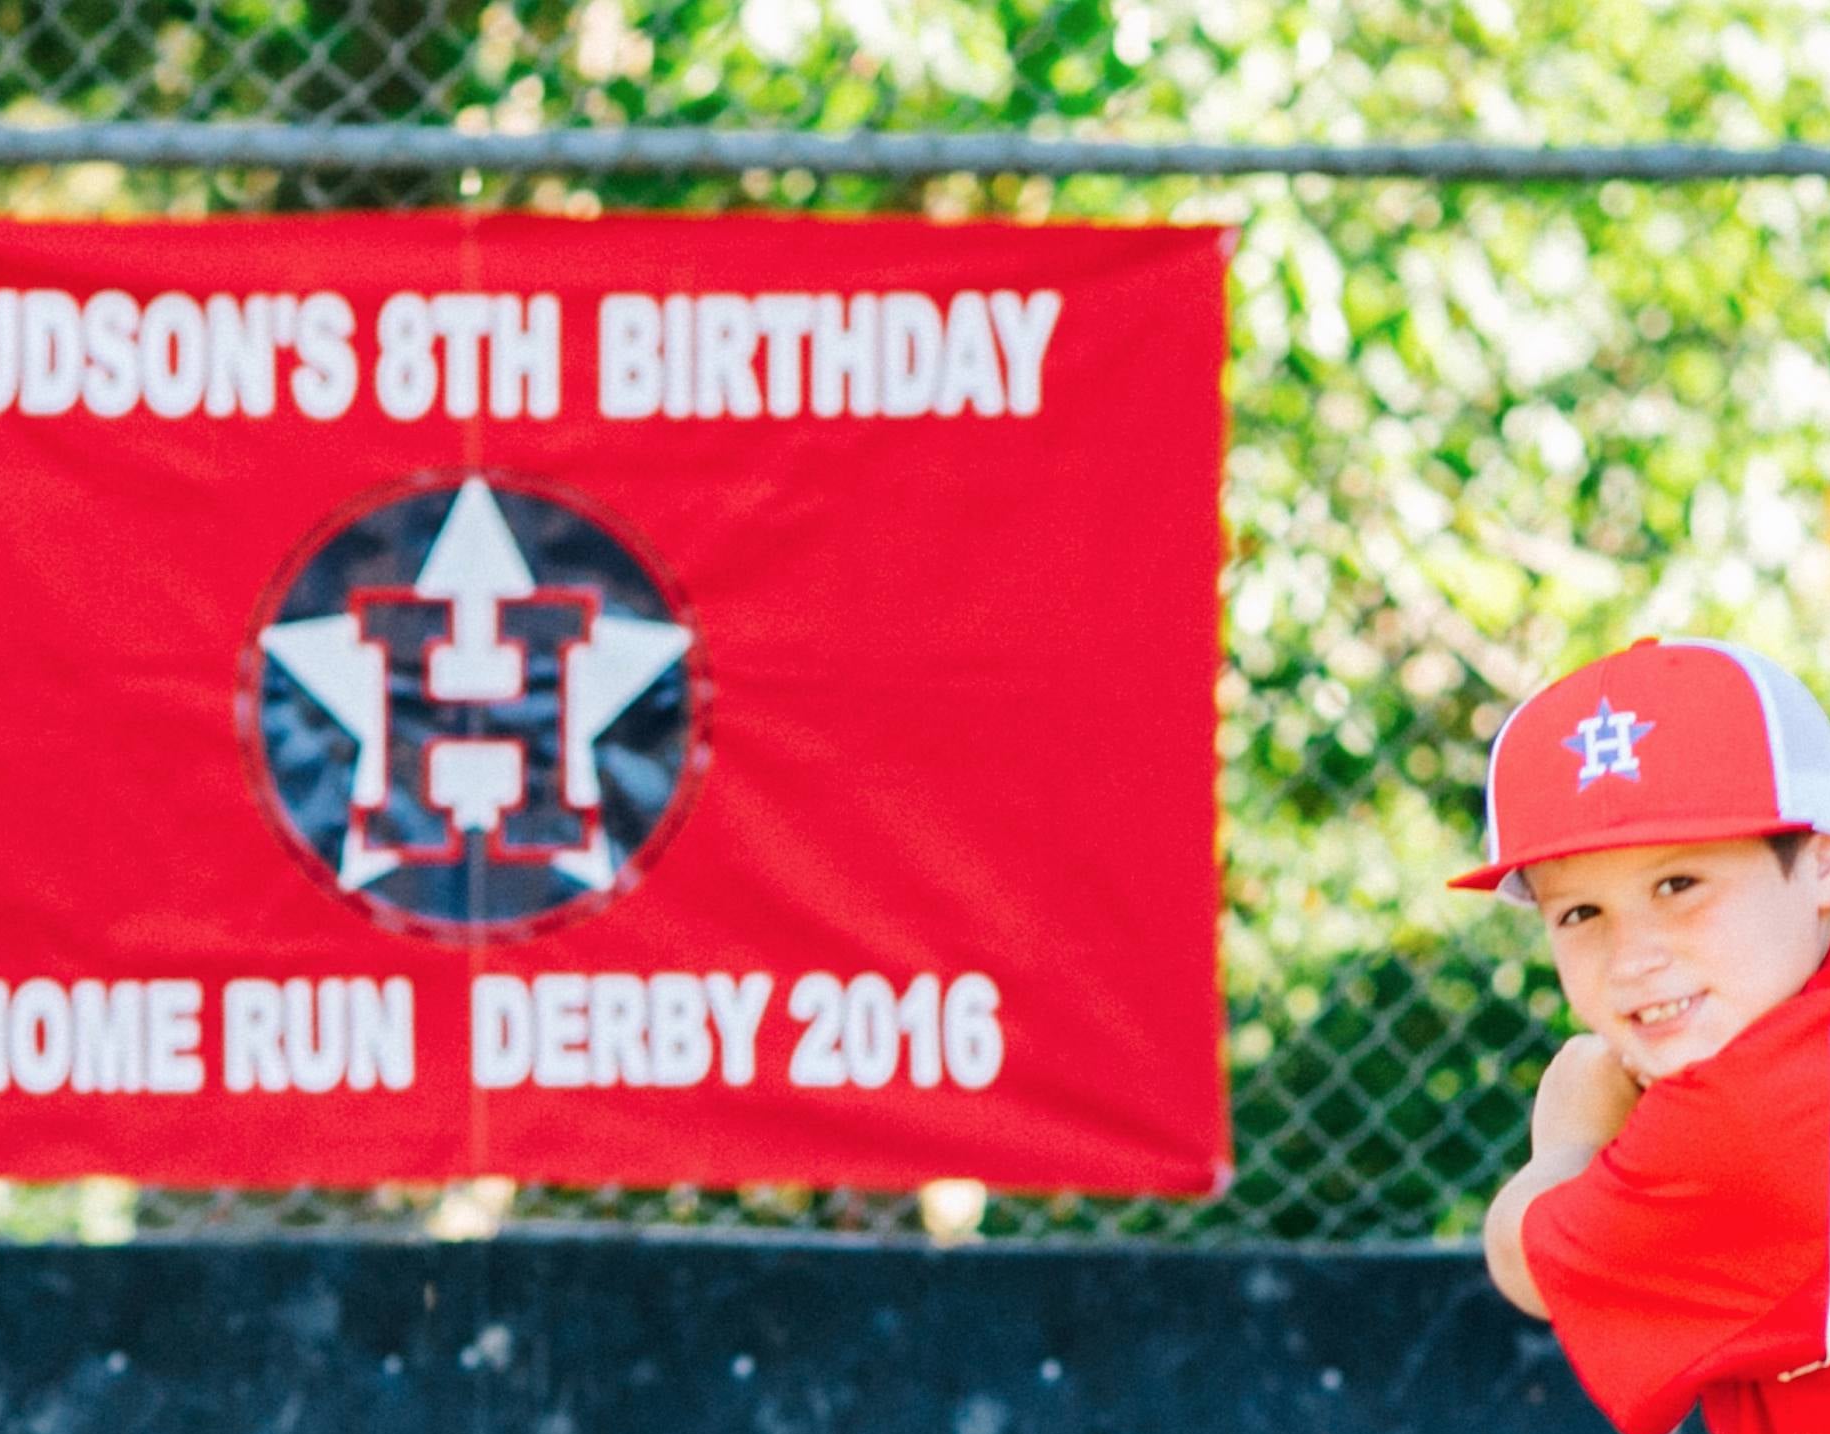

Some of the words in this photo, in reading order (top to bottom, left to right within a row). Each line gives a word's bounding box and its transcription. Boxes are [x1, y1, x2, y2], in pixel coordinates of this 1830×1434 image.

[373, 291, 563, 422] 8TH
[596, 289, 1064, 420] BIRTHDAY
[348, 585, 601, 861] H
[1576, 710, 1641, 778] H
[221, 976, 417, 1095] RUN
[468, 970, 775, 1091] DERBY
[786, 971, 1006, 1091] 2016
